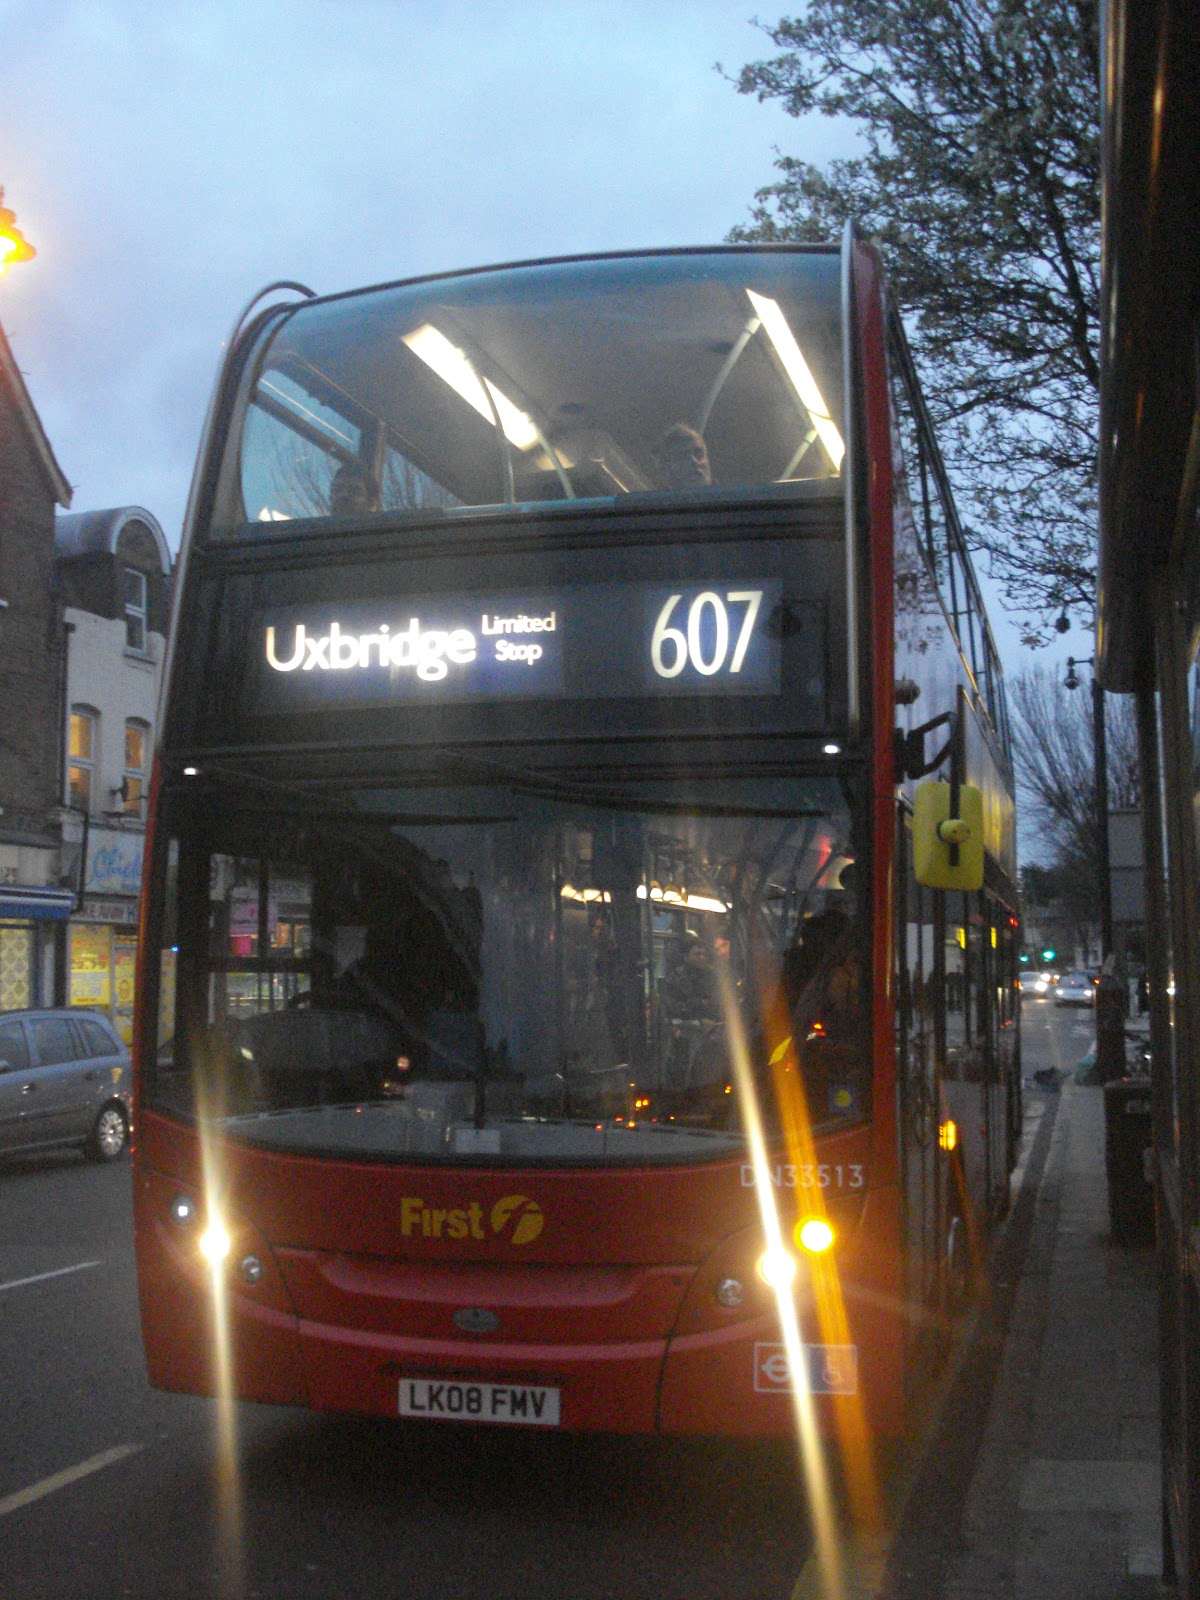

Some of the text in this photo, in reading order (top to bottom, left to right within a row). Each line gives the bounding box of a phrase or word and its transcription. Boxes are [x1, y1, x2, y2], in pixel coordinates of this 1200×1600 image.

[481, 611, 557, 636] Limited
[650, 590, 763, 679] 607
[265, 617, 477, 681] Uxbridge
[495, 640, 543, 666] Stop
[400, 1197, 485, 1240] First
[490, 1387, 548, 1419] FMV
